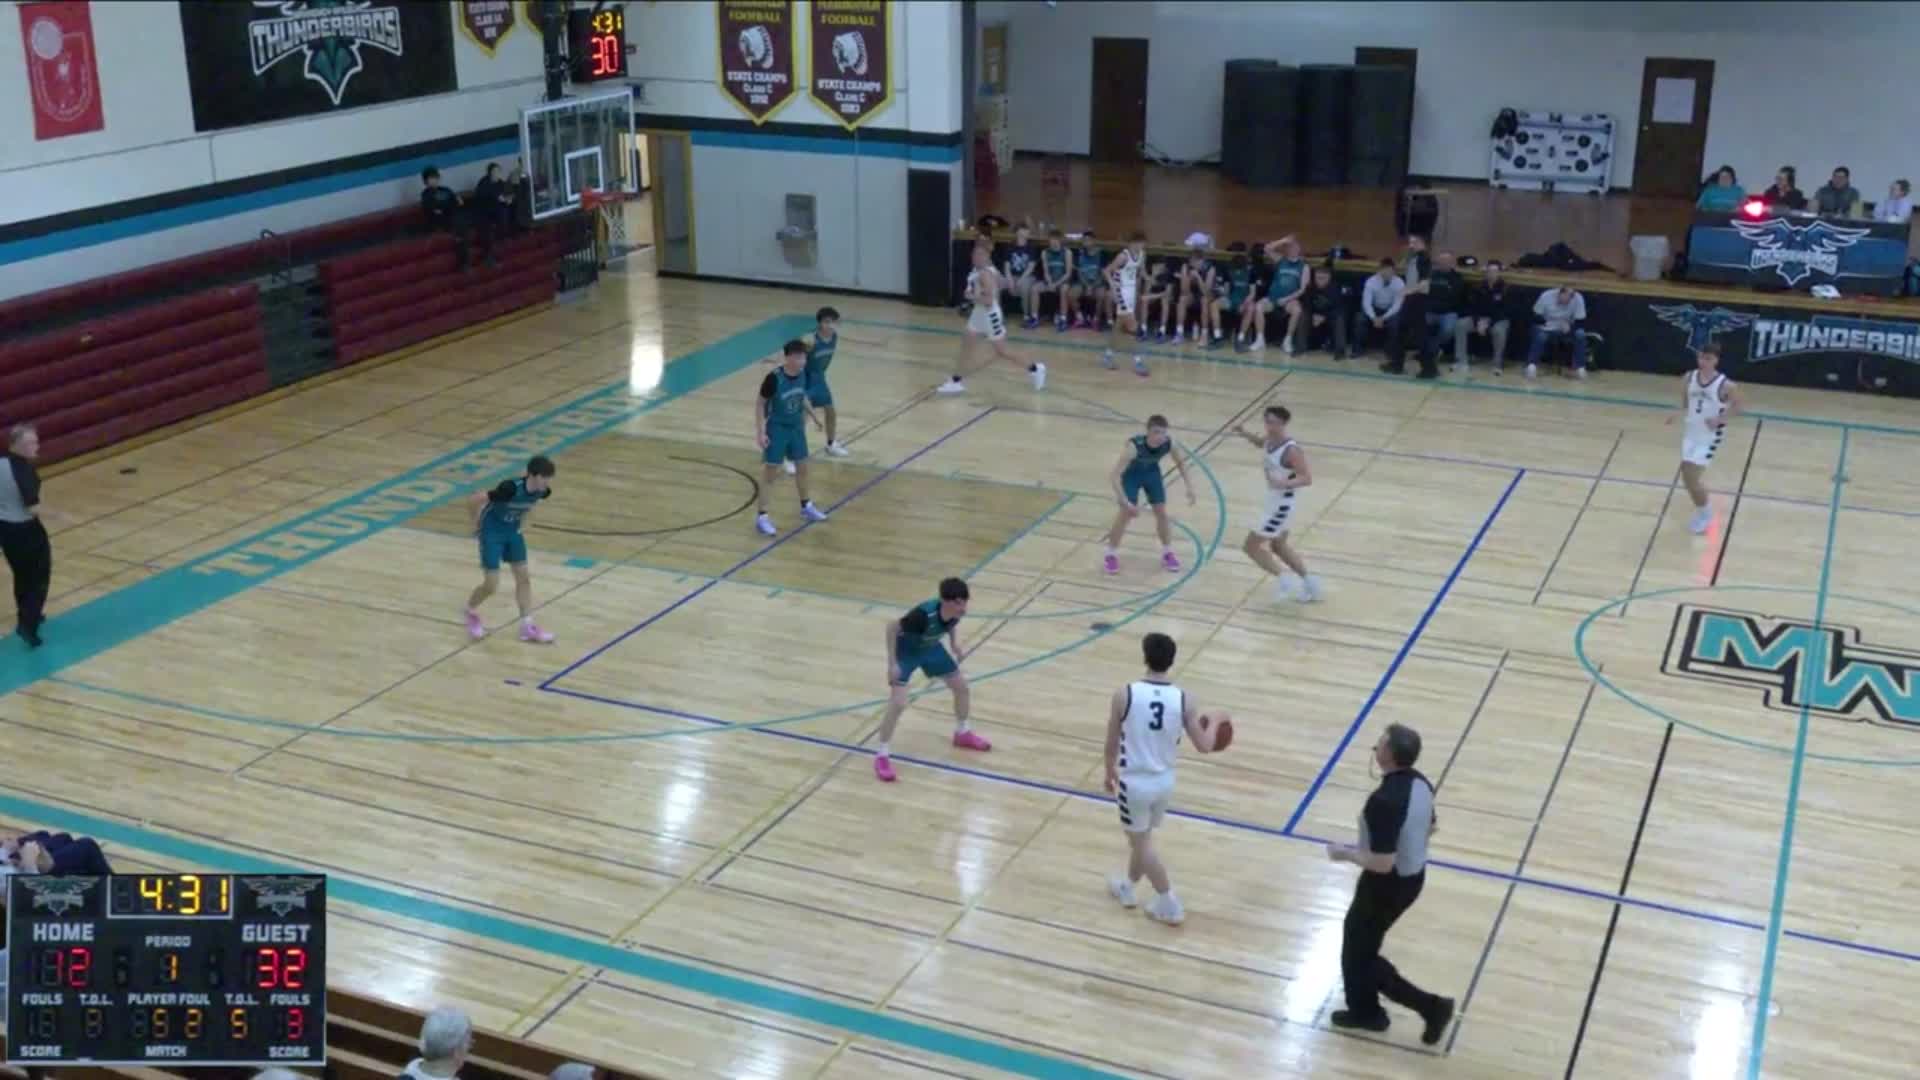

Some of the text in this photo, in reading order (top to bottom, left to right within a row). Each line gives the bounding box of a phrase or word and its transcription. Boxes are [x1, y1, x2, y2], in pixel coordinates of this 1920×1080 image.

[253, 11, 397, 65] THUNDERBIRDS
[821, 14, 876, 26] FOOTBALL
[591, 35, 618, 75] 30
[192, 386, 668, 579] THUNDERBIRD
[1148, 701, 1165, 731] 3
